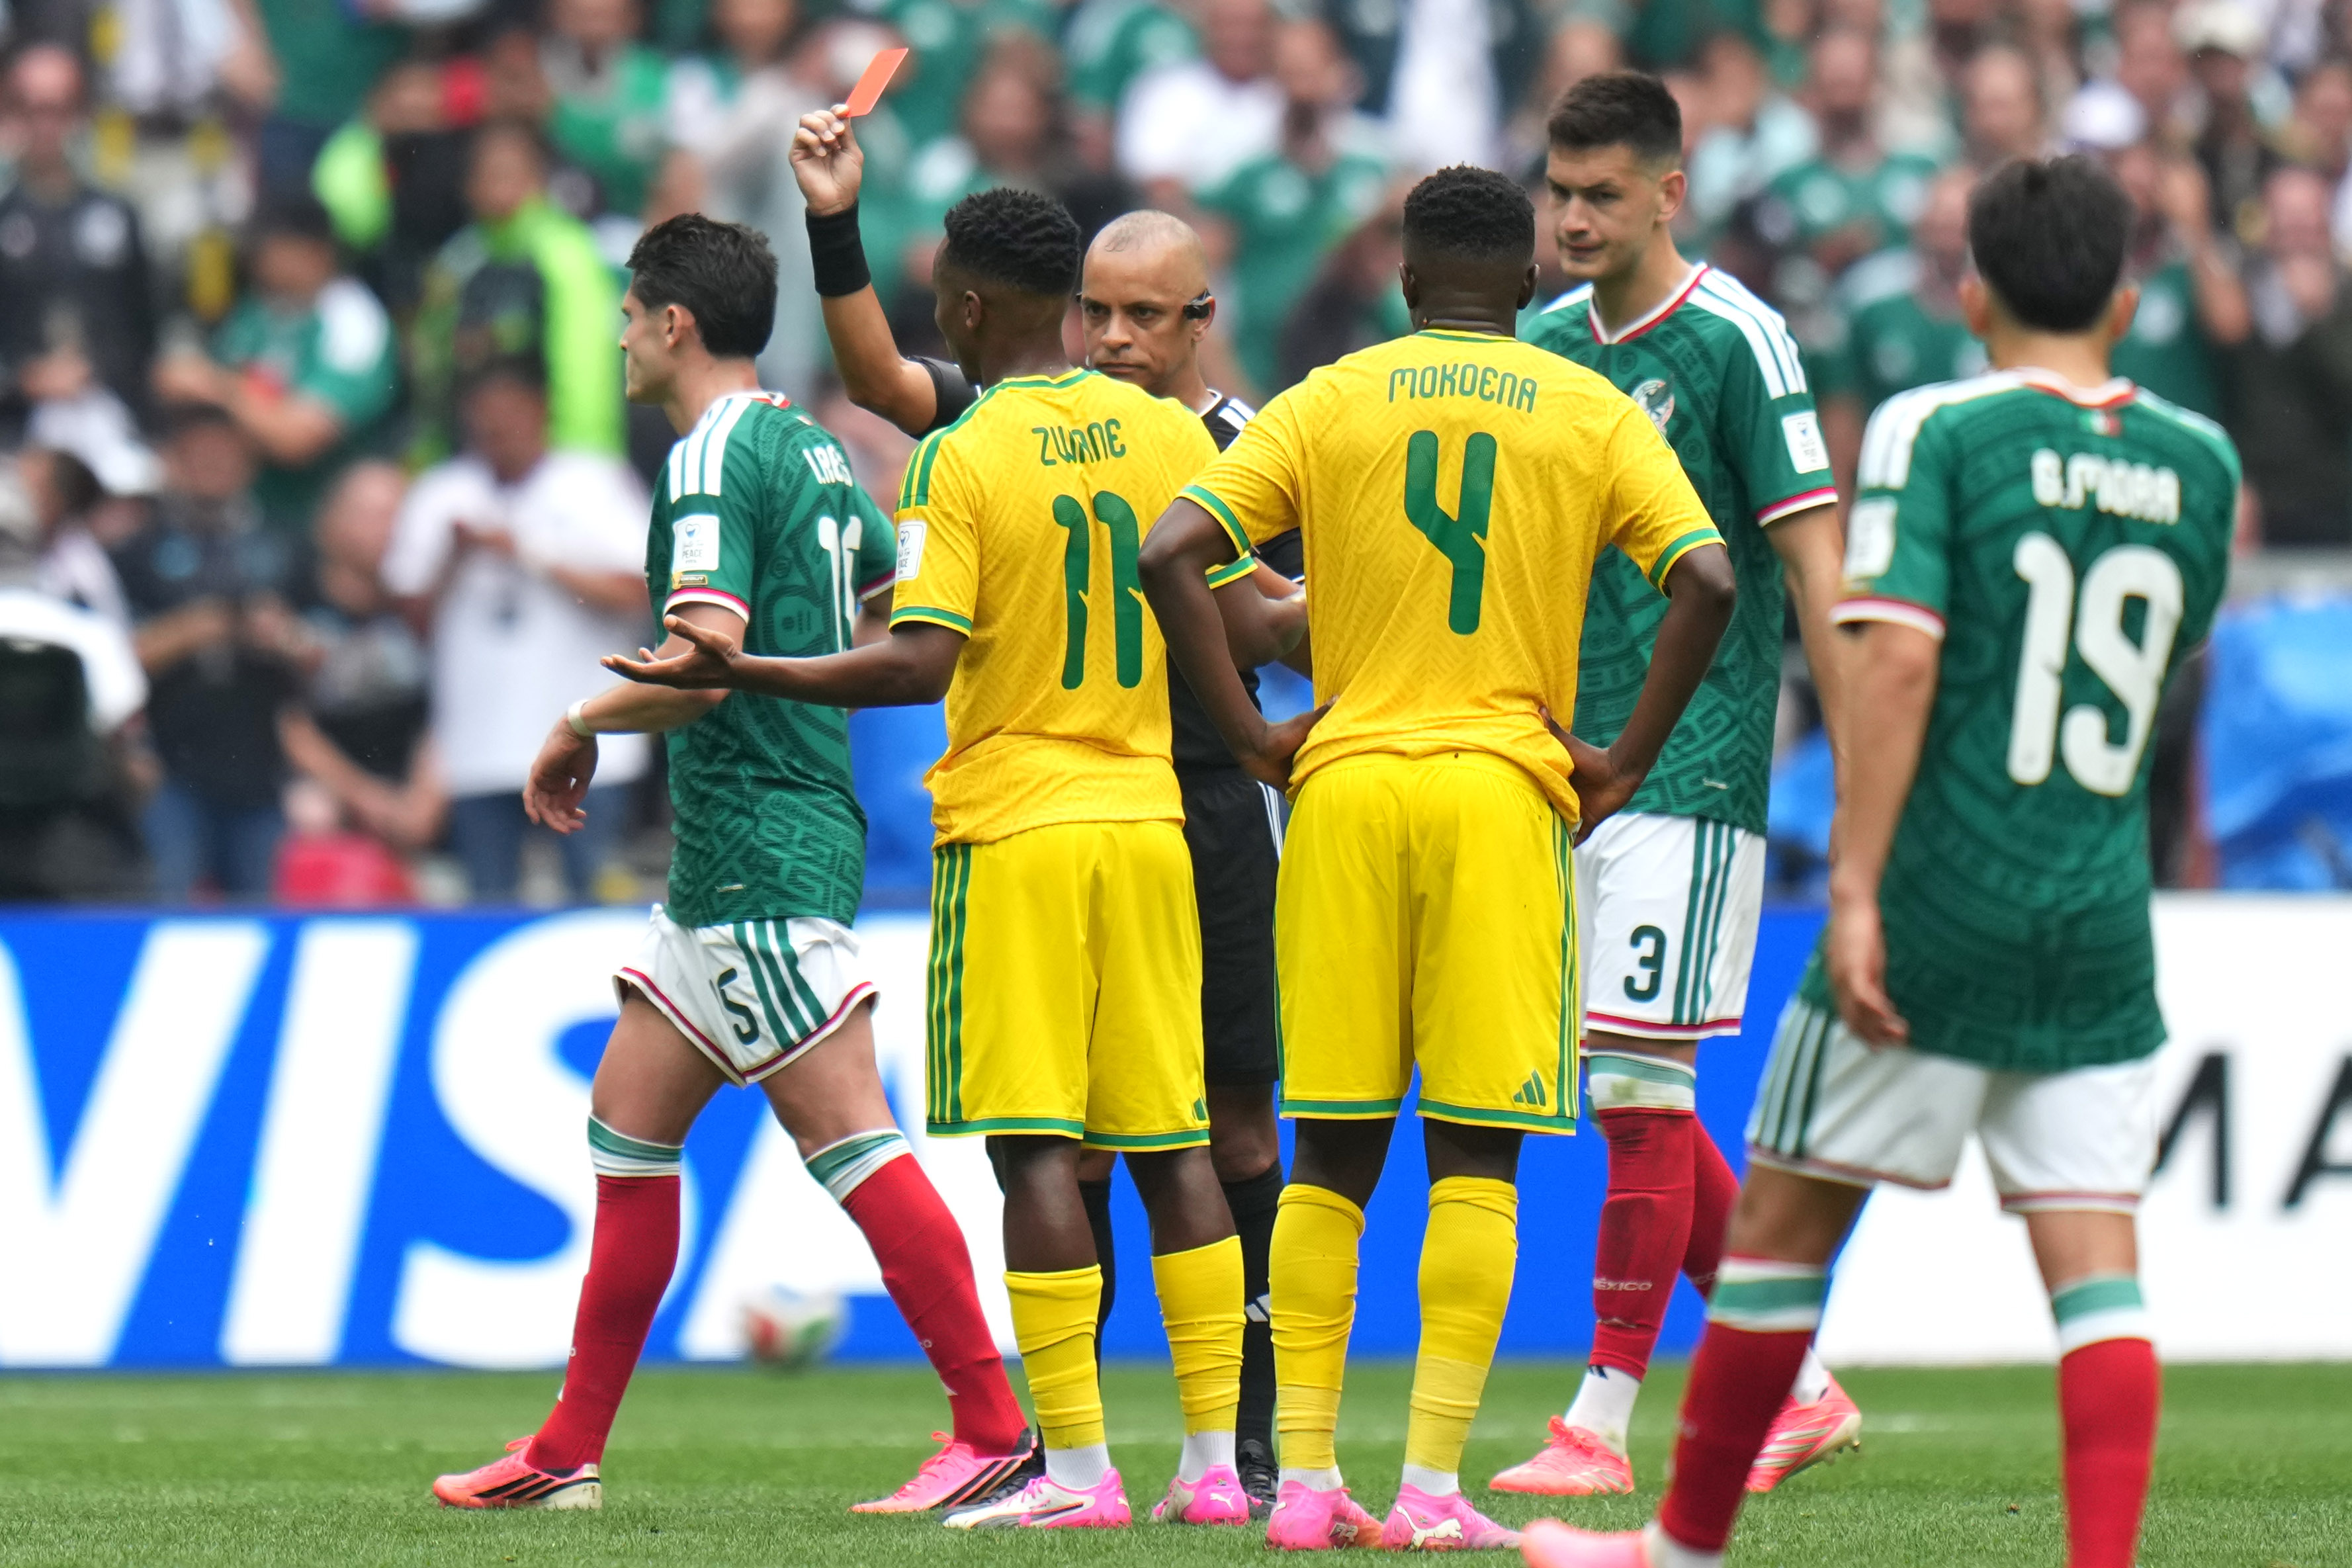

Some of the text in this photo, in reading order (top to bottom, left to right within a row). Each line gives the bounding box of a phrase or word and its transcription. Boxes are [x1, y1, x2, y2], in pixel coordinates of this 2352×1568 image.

[1389, 363, 1537, 414] MOKOENA
[1031, 418, 1126, 466] ZWANE
[1404, 430, 1497, 635] 4
[1053, 490, 1143, 689] 11
[2007, 531, 2183, 796] 19
[1624, 925, 1667, 1002] 3
[709, 967, 760, 1045] 5
